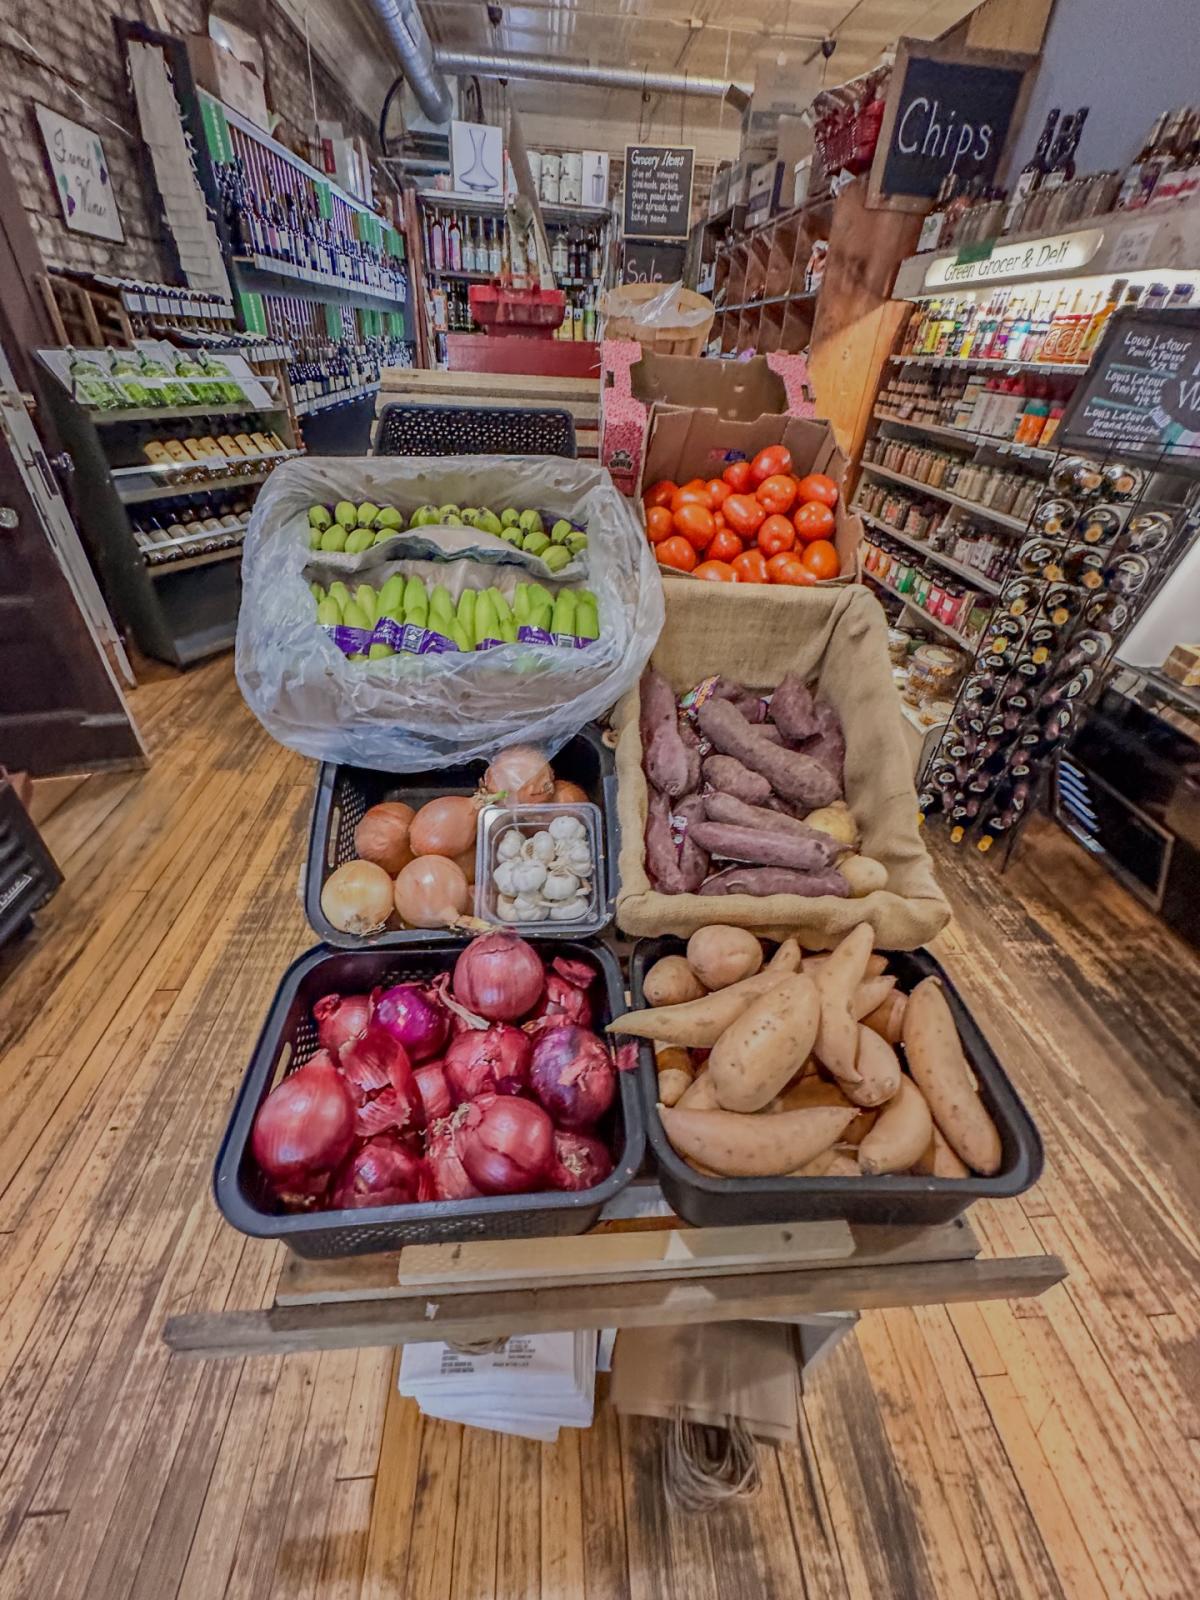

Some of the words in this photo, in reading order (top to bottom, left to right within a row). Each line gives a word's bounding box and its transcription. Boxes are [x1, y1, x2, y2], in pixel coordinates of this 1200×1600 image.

[899, 97, 993, 175] Chips
[631, 149, 660, 170] Grocery
[661, 150, 685, 168] Items
[670, 202, 680, 213] and
[631, 210, 648, 224] baking
[650, 213, 667, 224] needs
[944, 263, 976, 281] Green
[978, 256, 1021, 276] Grocer
[1021, 247, 1034, 269] &
[1036, 240, 1070, 267] Deli
[626, 258, 663, 284] Sale
[1124, 330, 1152, 347] Louis
[1151, 334, 1192, 352] Latour
[1105, 369, 1130, 383] Louis
[1131, 372, 1168, 387] Latour
[1110, 382, 1137, 395] Pinot
[1137, 385, 1161, 396] Noir
[1083, 405, 1110, 419] Louis
[1111, 409, 1149, 423] Latour
[1093, 418, 1121, 430] Grand
